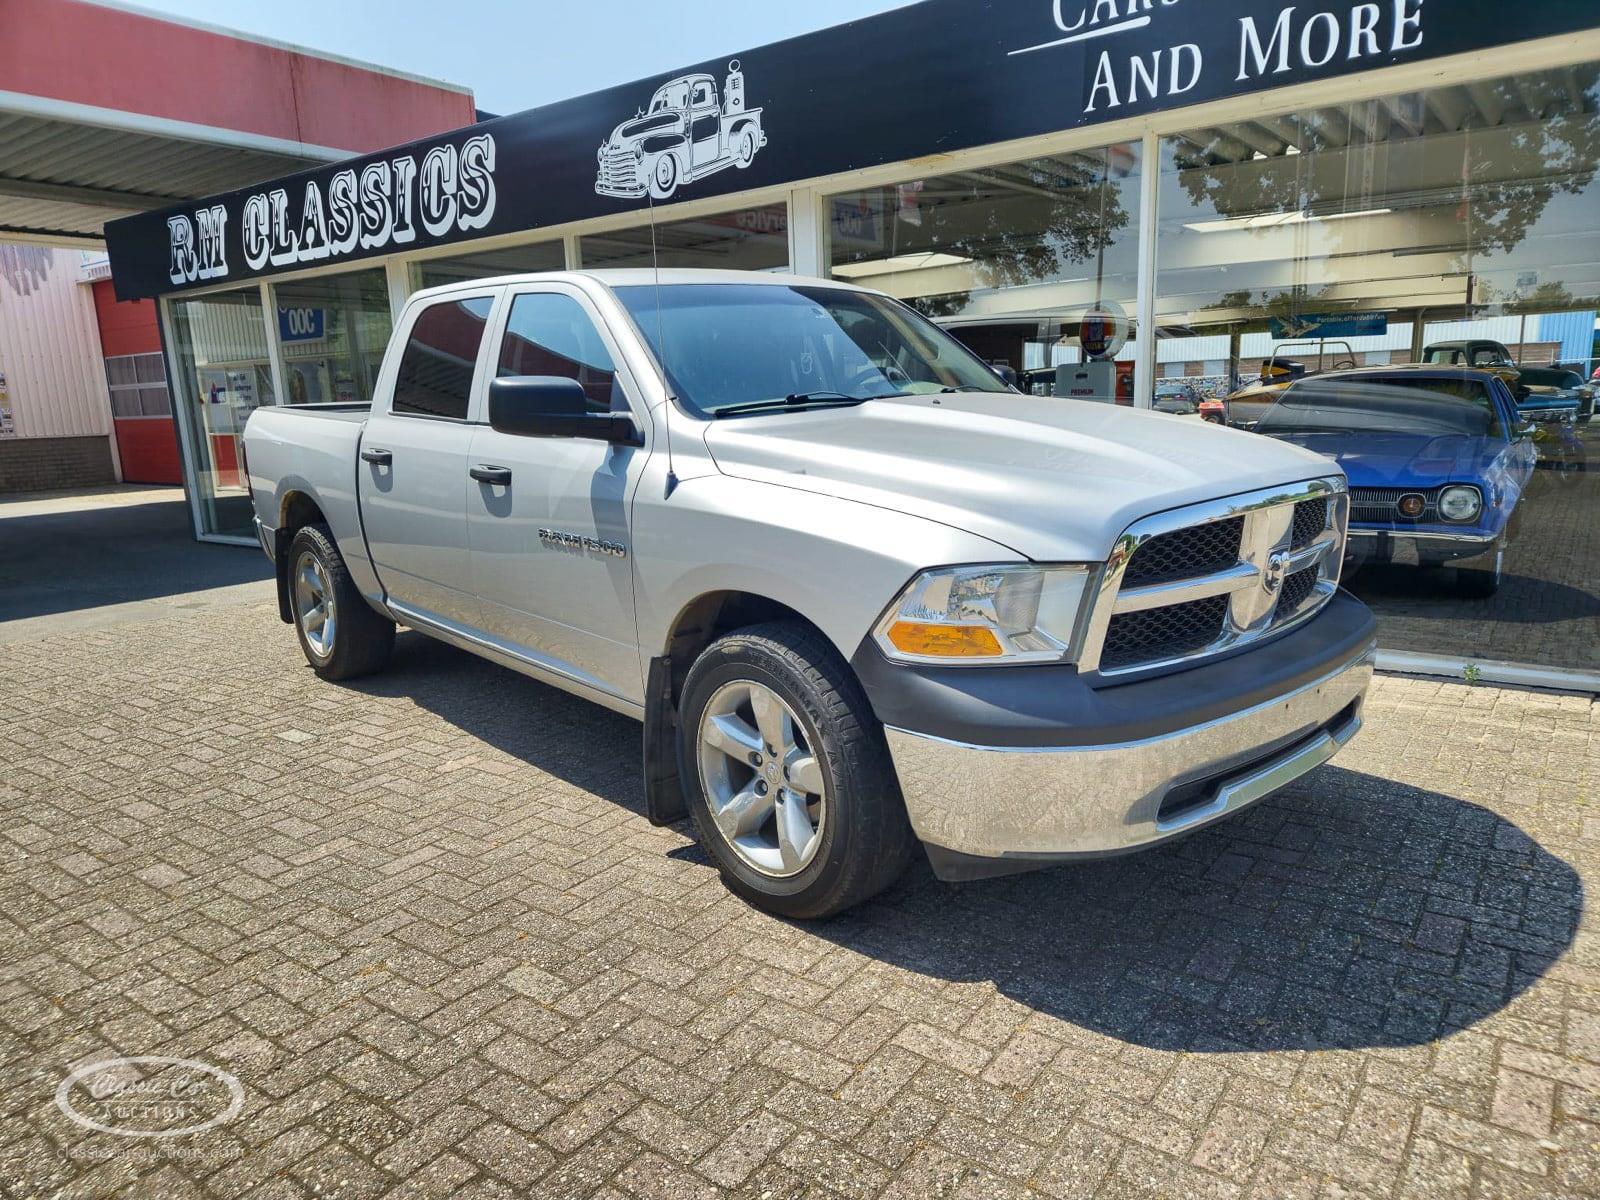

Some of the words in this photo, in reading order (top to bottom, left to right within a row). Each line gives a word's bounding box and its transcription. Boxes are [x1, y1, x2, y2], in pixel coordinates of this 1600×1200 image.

[1053, 0, 1179, 32] CA
[1083, 43, 1203, 113] AND
[1234, 0, 1424, 81] MORE
[167, 204, 229, 285] RM
[242, 132, 497, 271] CLASSICS
